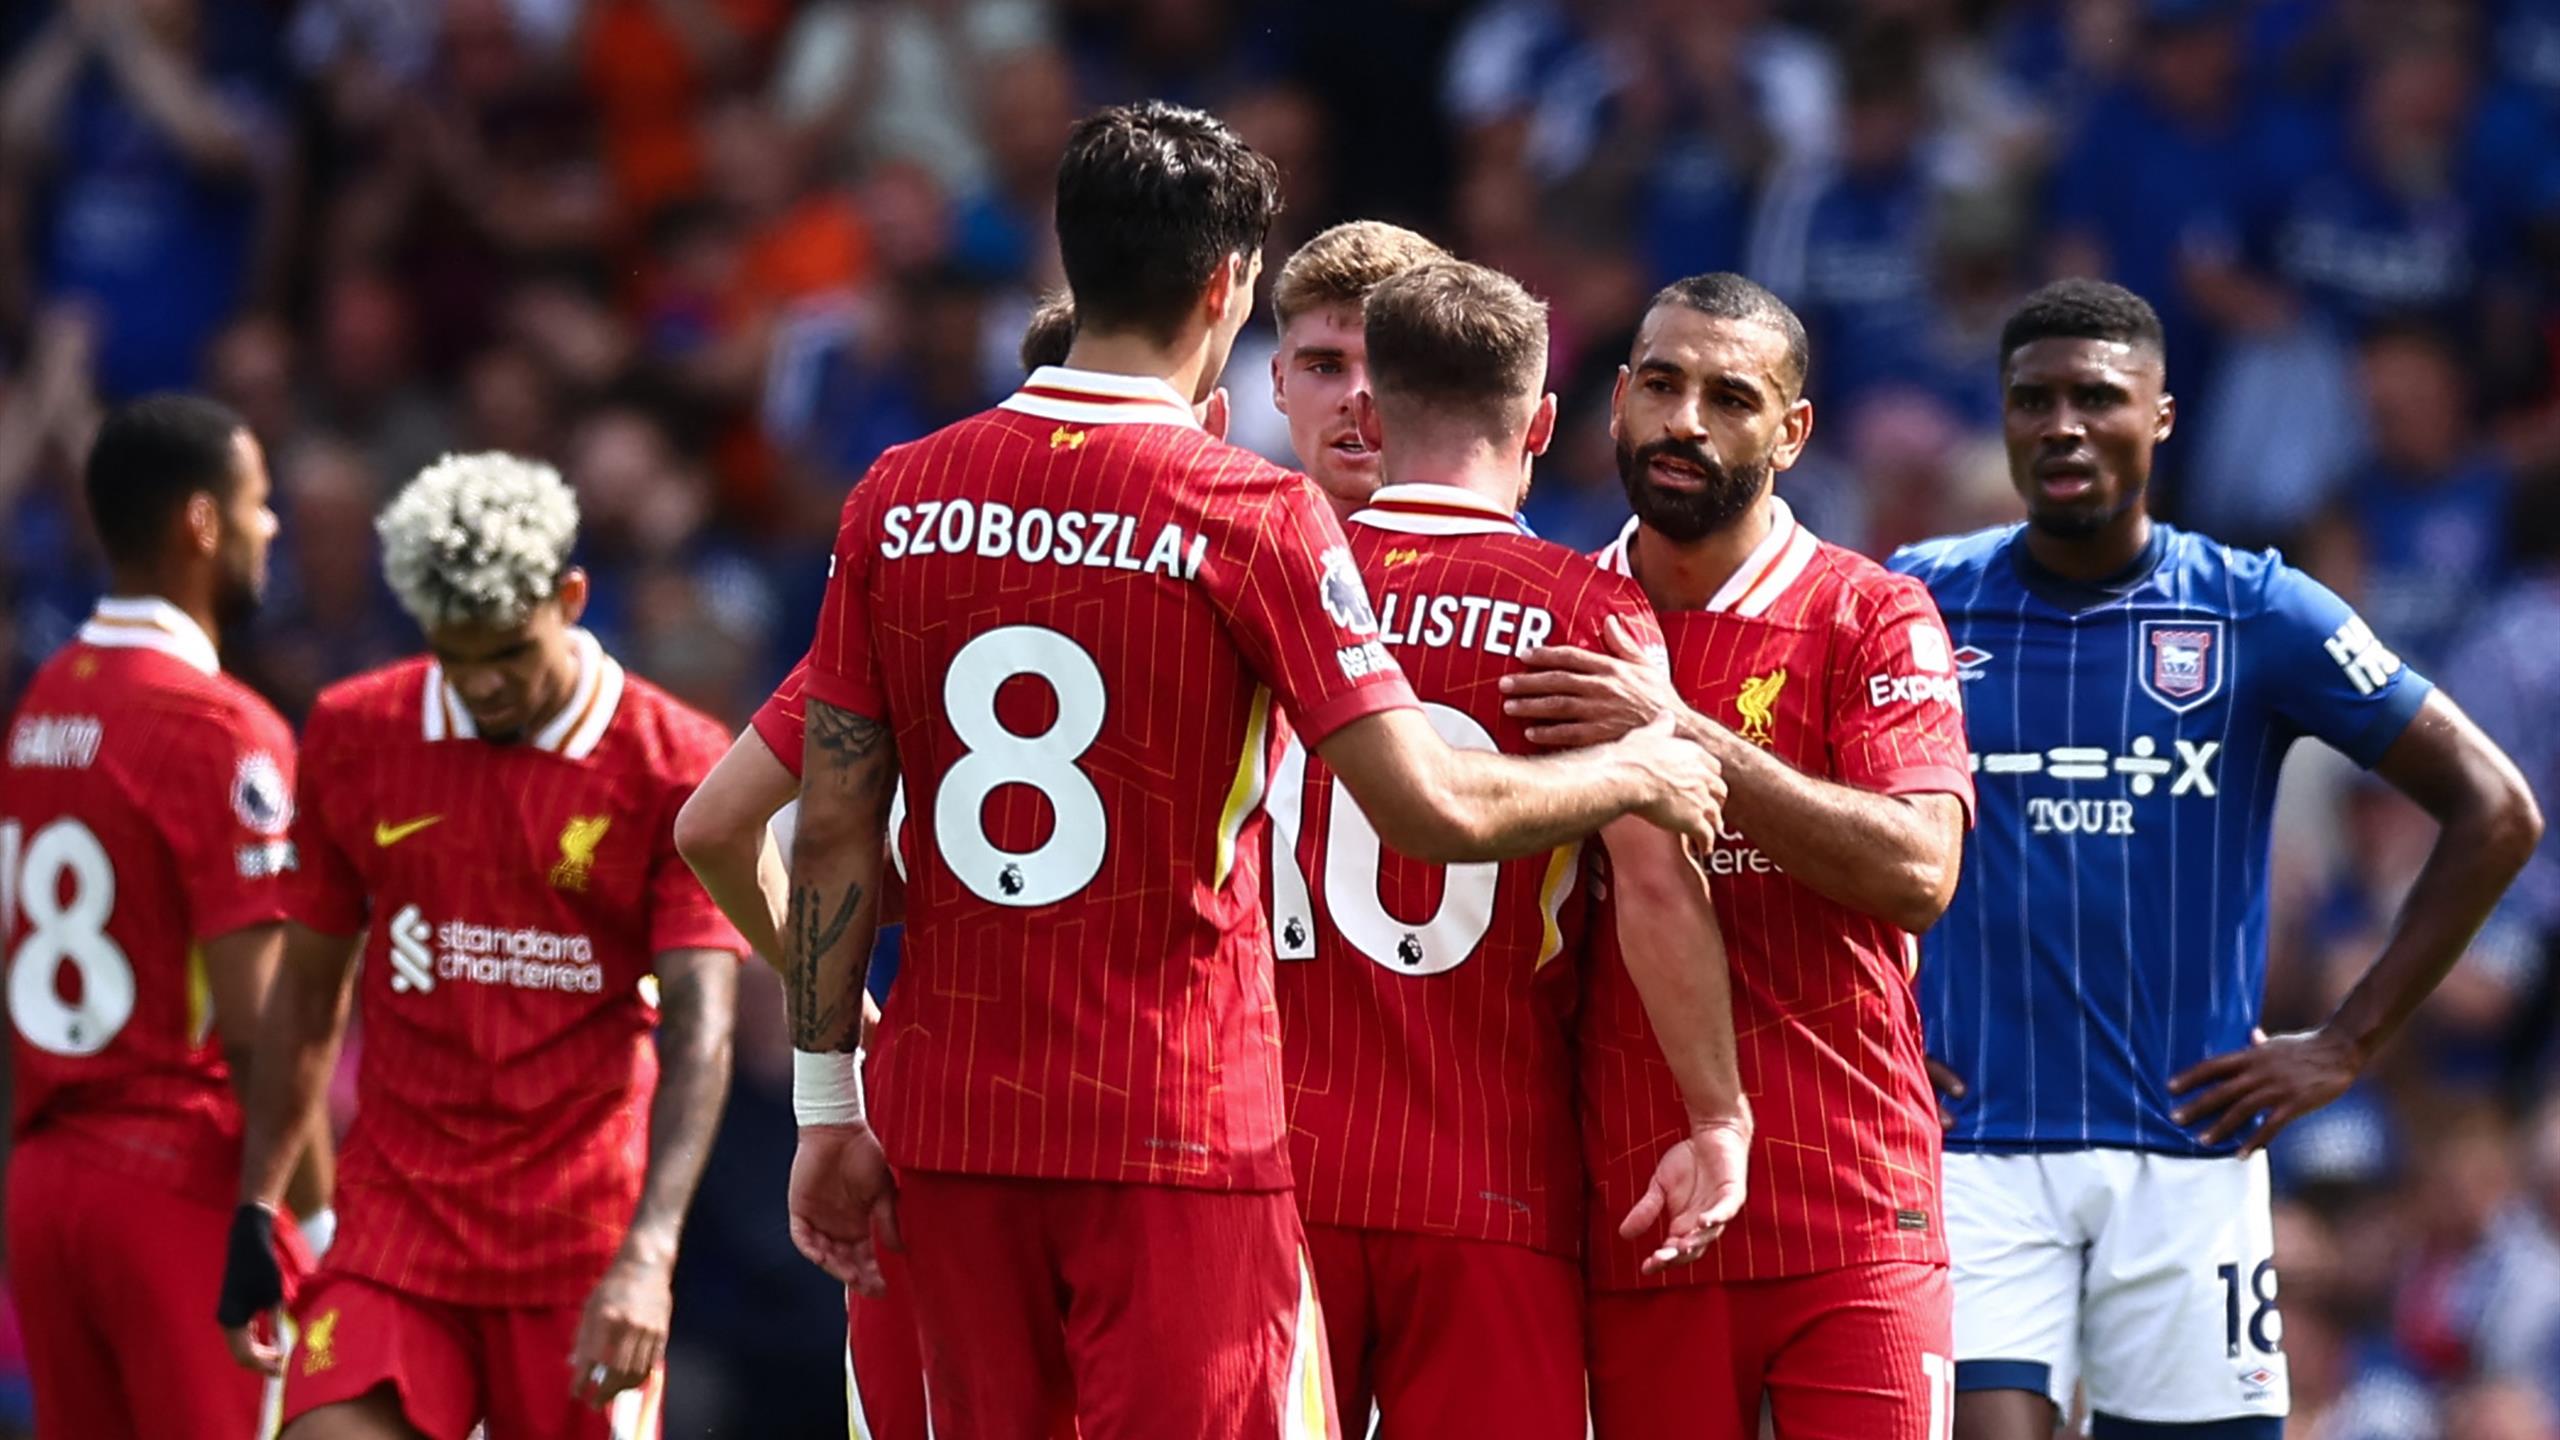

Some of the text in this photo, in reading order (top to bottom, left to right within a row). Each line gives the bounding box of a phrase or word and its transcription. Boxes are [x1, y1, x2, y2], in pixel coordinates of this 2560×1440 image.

[880, 498, 1208, 580] SZOBOSZLAI
[1379, 593, 1552, 658] LISTER
[934, 624, 1107, 906] 8
[2027, 801, 2134, 835] TOUR
[437, 918, 592, 963] standard
[437, 952, 602, 993] chartered
[2218, 1259, 2284, 1358] 18
